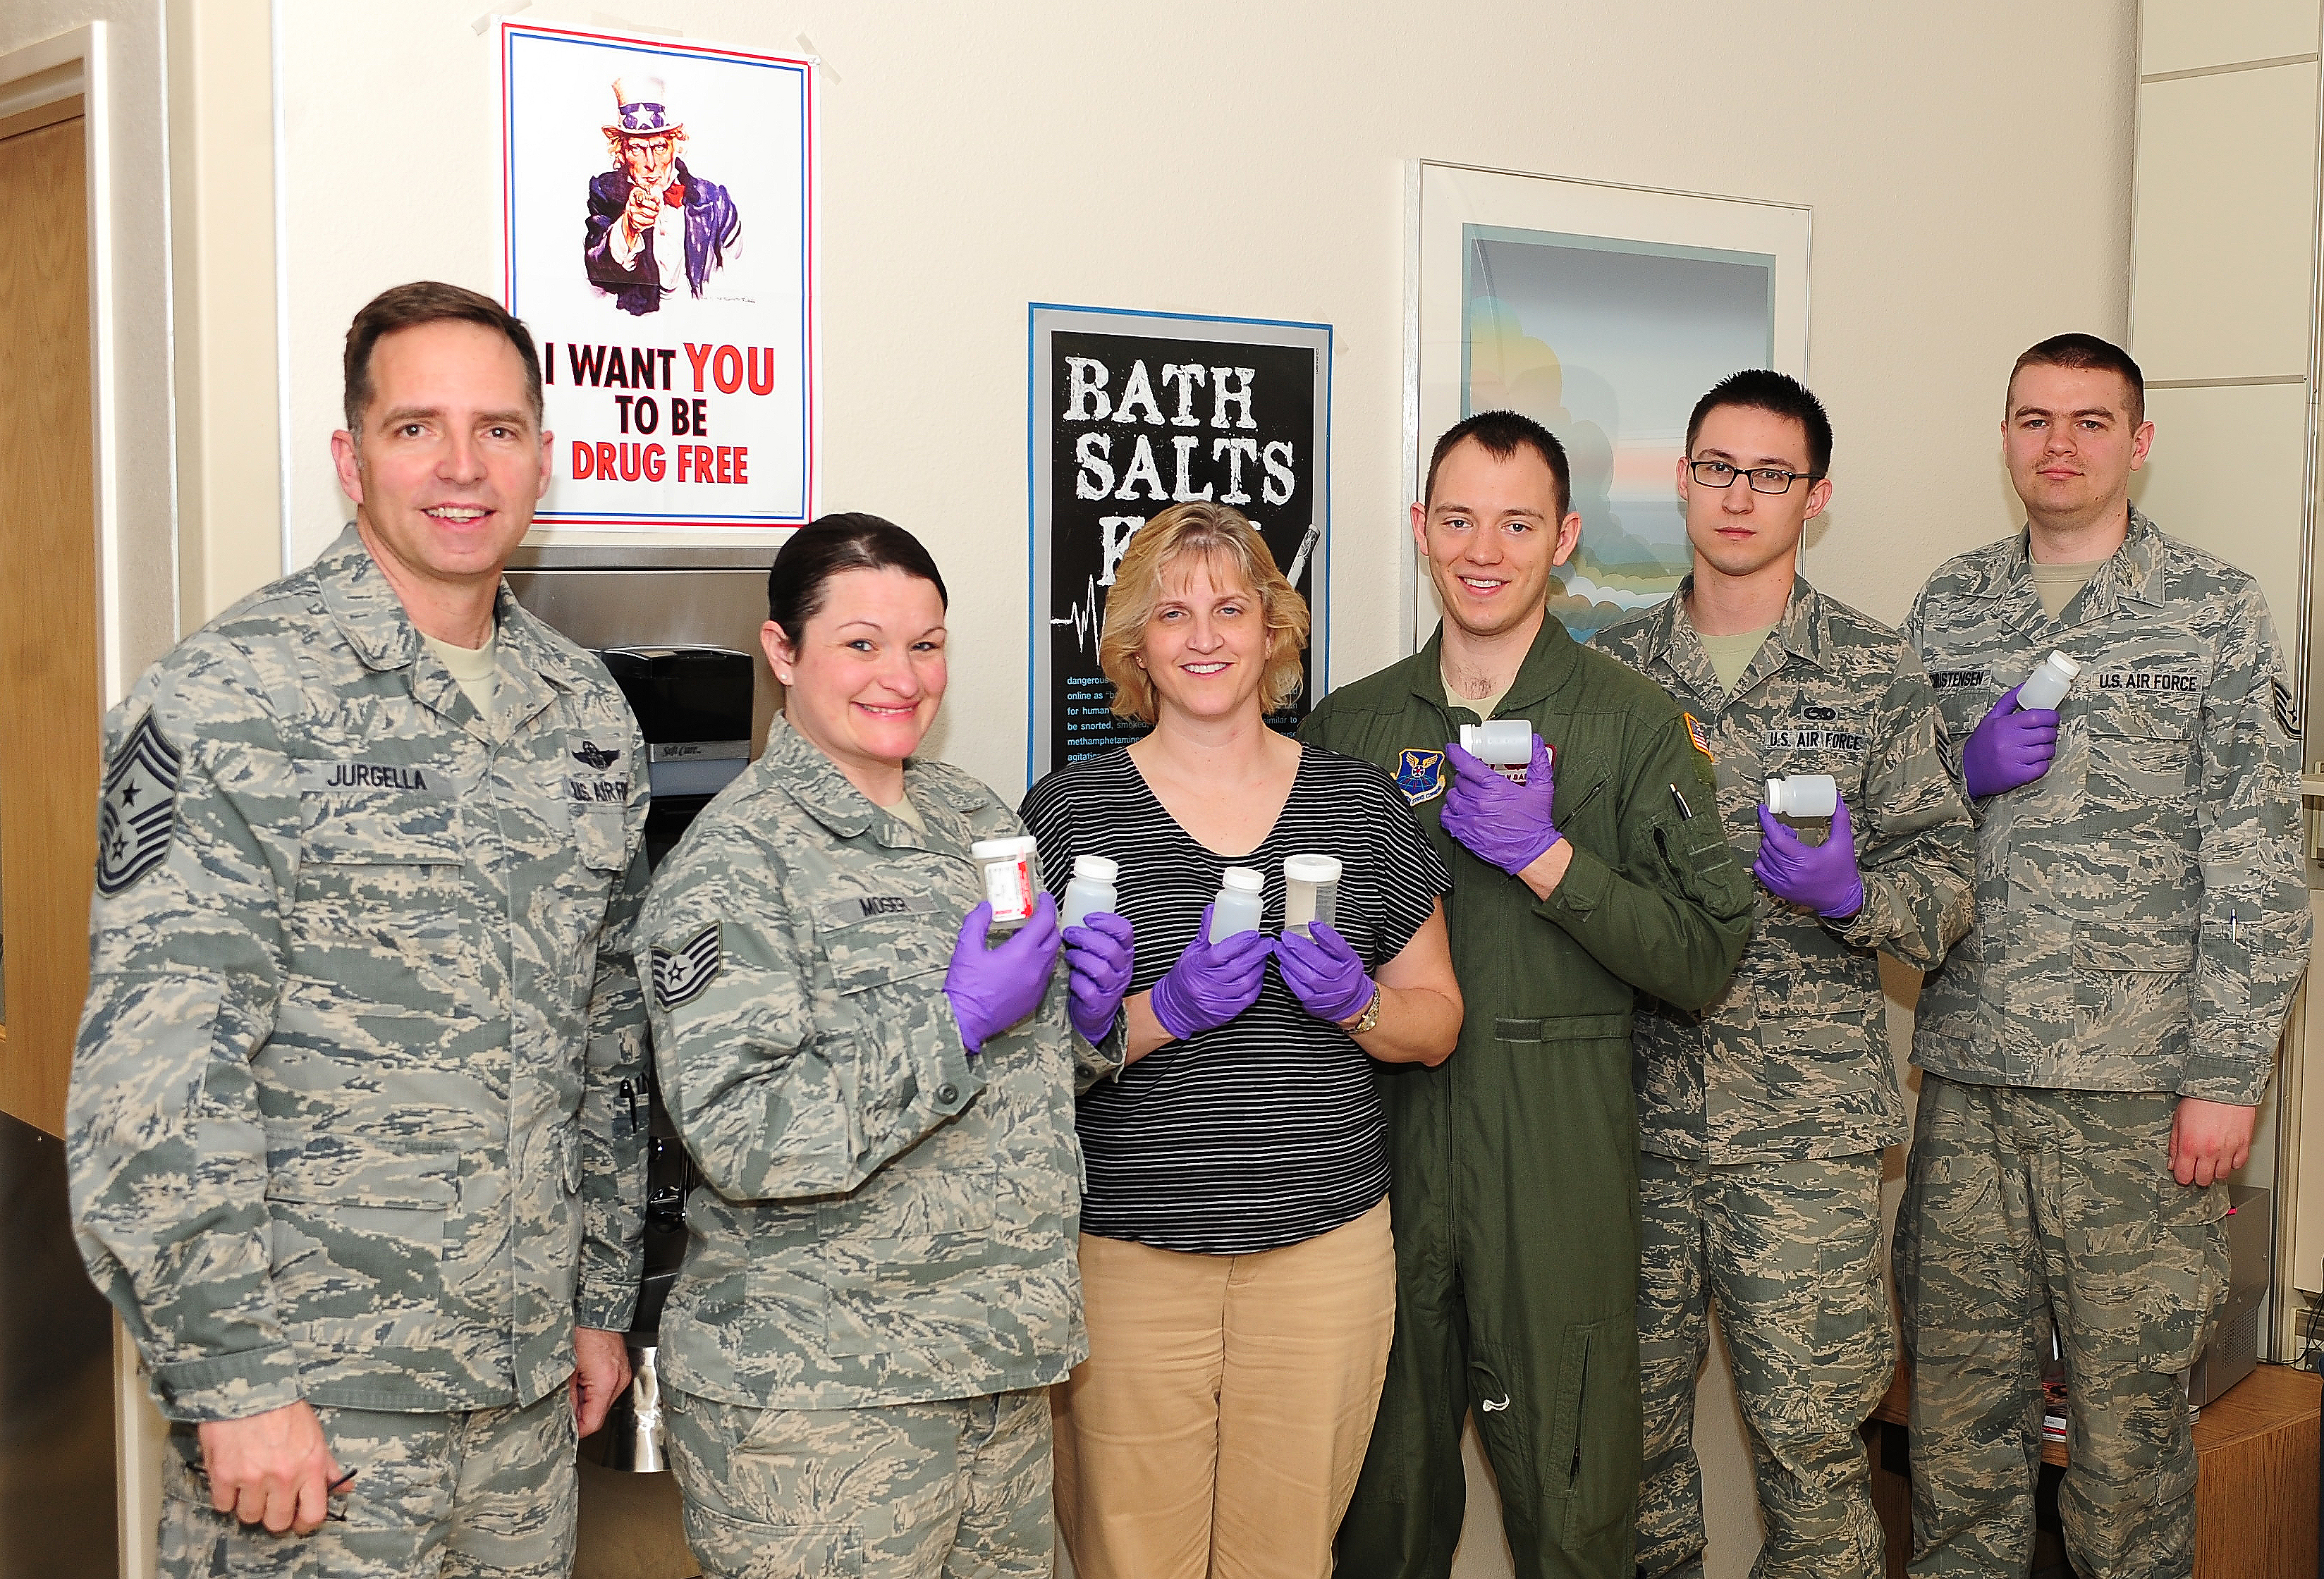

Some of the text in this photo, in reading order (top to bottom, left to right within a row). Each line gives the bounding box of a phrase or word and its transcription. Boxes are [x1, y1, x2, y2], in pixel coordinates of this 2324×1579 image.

[545, 342, 774, 395] I WANT YOU
[1063, 356, 1257, 429] BATH
[615, 395, 707, 437] TO BE
[572, 441, 748, 484] DRUG FREE
[1075, 432, 1295, 505] SALTS
[2100, 673, 2198, 692] U.S. AIR FORCE
[1067, 691, 1091, 700] online
[1067, 706, 1110, 715] for human
[1067, 722, 1077, 731] be
[1081, 720, 1113, 730] snorted,
[1770, 731, 1863, 751] U.S. AIR FORCE
[327, 764, 427, 790] JURGELLA
[593, 781, 617, 802] AIR
[859, 897, 912, 917] MOSER
